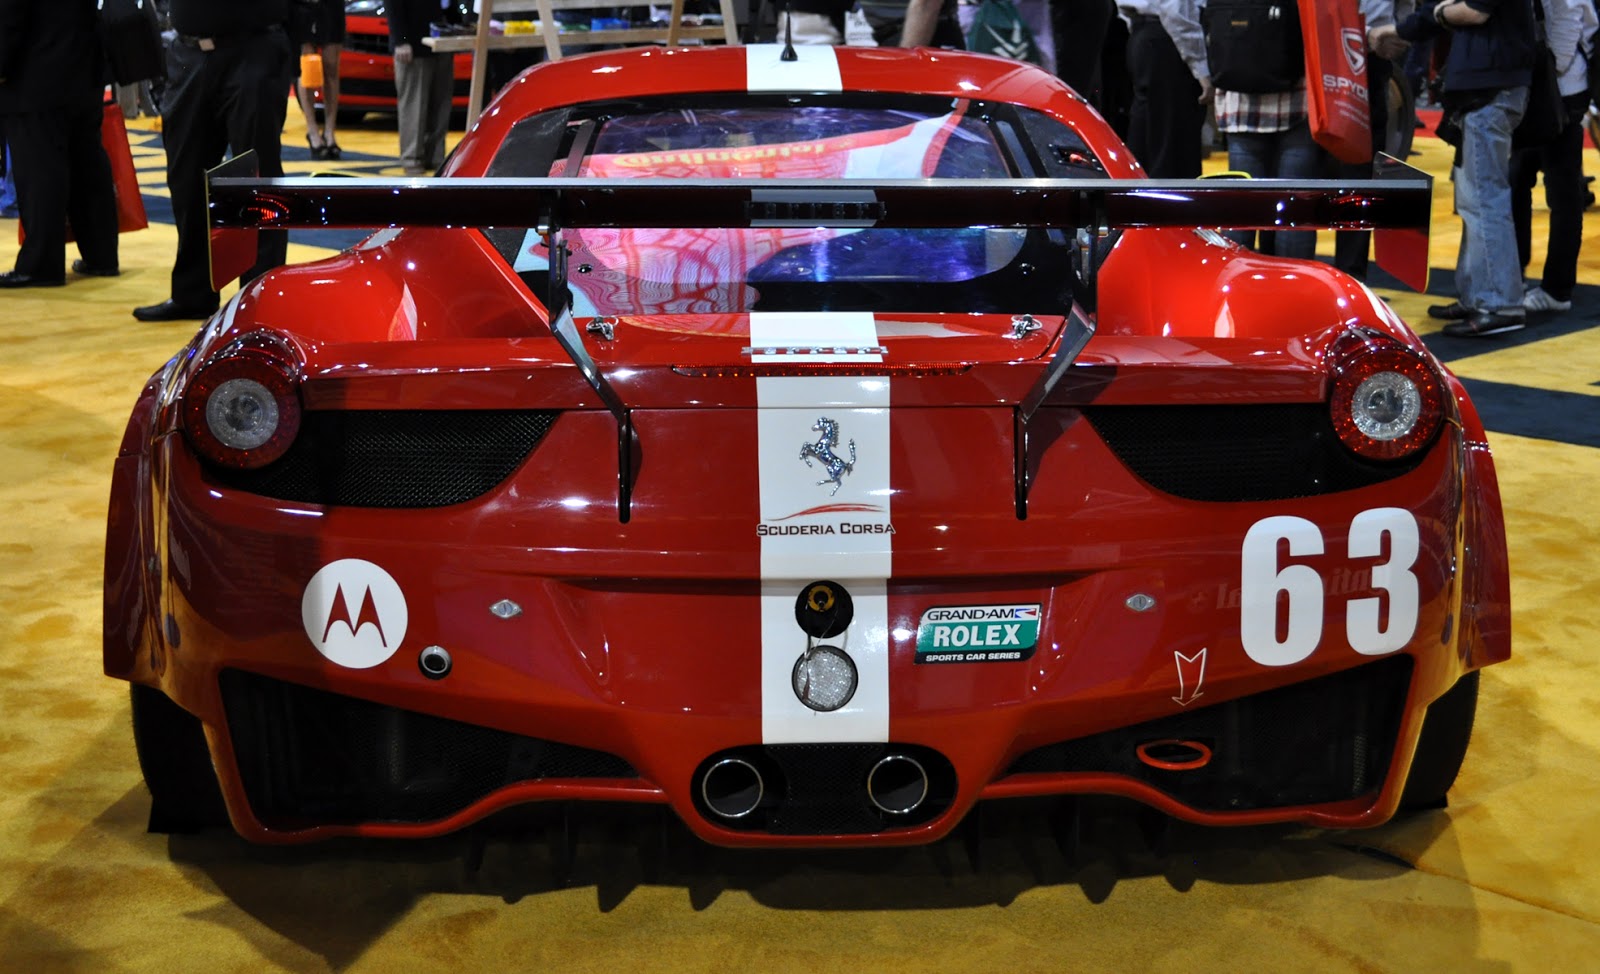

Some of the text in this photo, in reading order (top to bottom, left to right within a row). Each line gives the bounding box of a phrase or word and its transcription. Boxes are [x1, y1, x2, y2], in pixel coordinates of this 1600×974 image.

[757, 522, 896, 536] SCUDERIA CORSA
[1241, 507, 1420, 667] 63
[933, 624, 1021, 647] ROLEX
[925, 651, 1021, 662] SPORTS CAR SERIES
